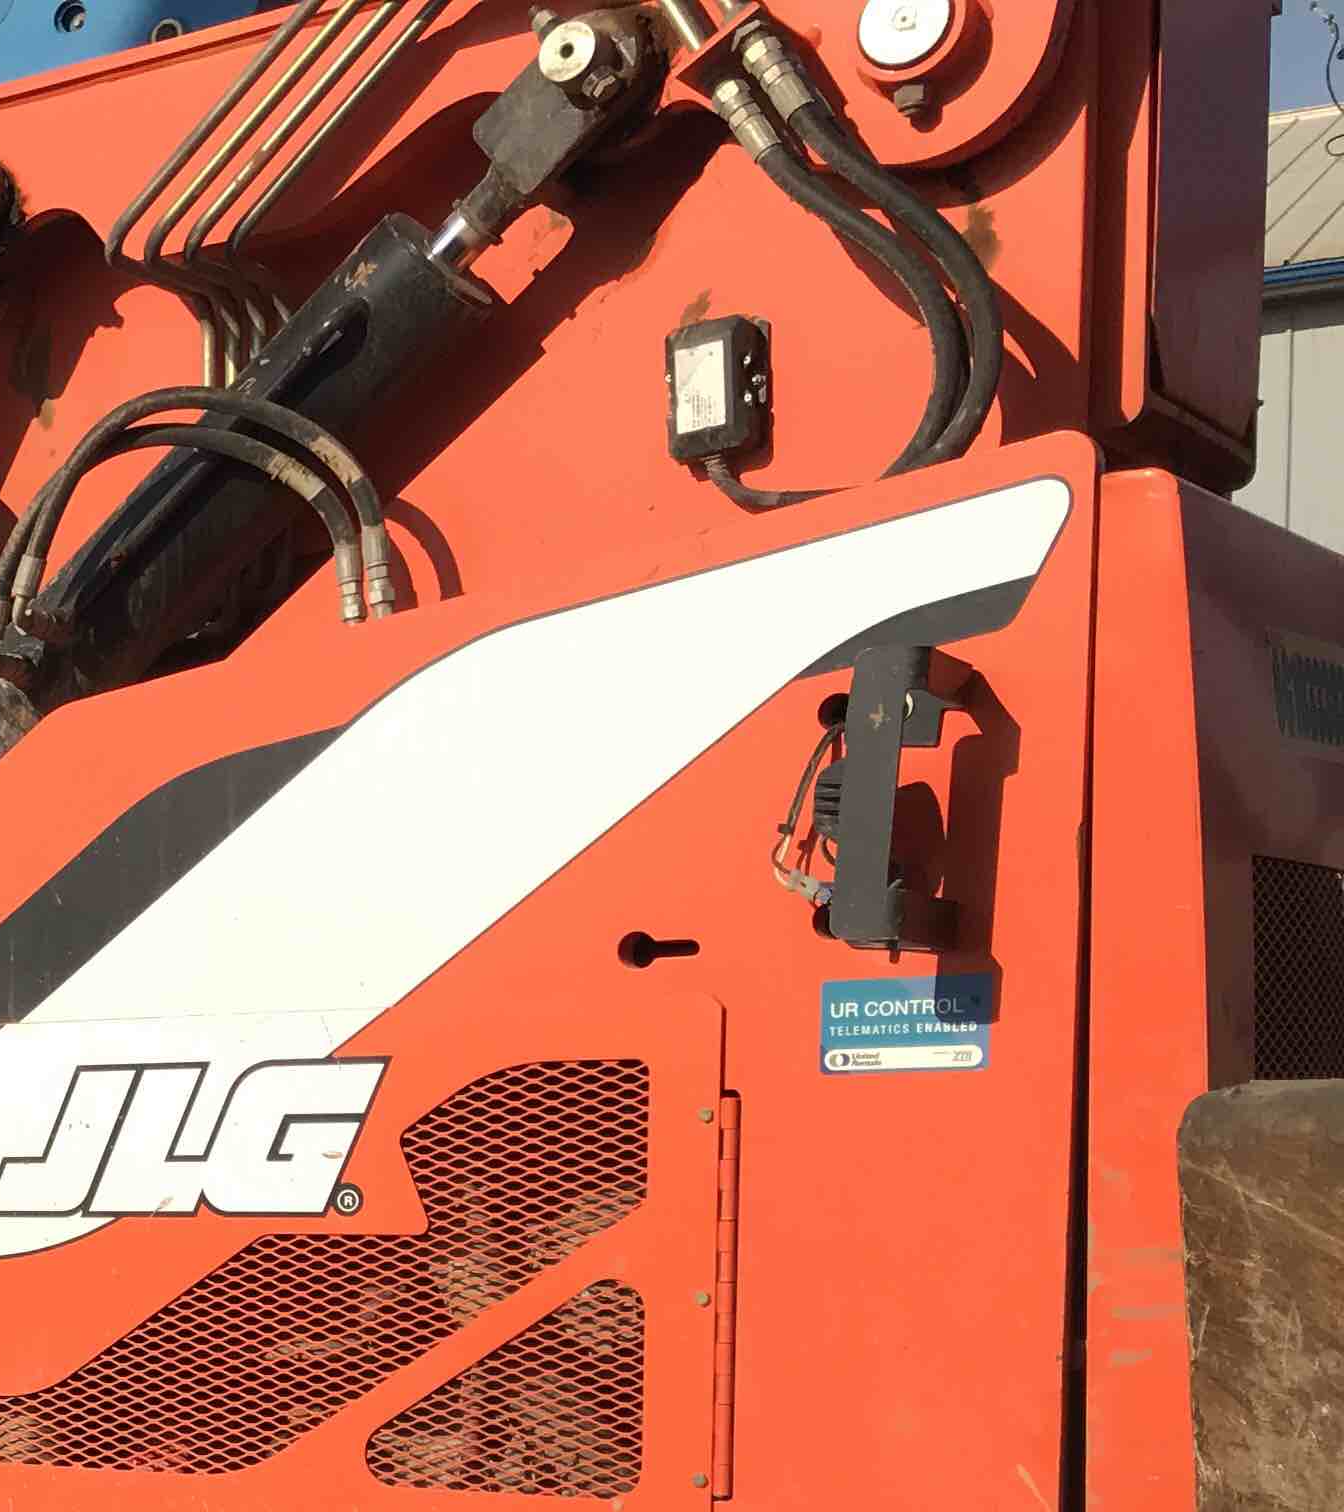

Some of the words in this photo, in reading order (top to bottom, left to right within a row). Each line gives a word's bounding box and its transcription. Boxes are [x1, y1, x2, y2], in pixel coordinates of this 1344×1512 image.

[830, 1001, 859, 1018] UR
[864, 997, 964, 1017] CONTROL
[829, 1023, 910, 1037] TELEMATICS
[916, 1021, 978, 1033] ENABLED
